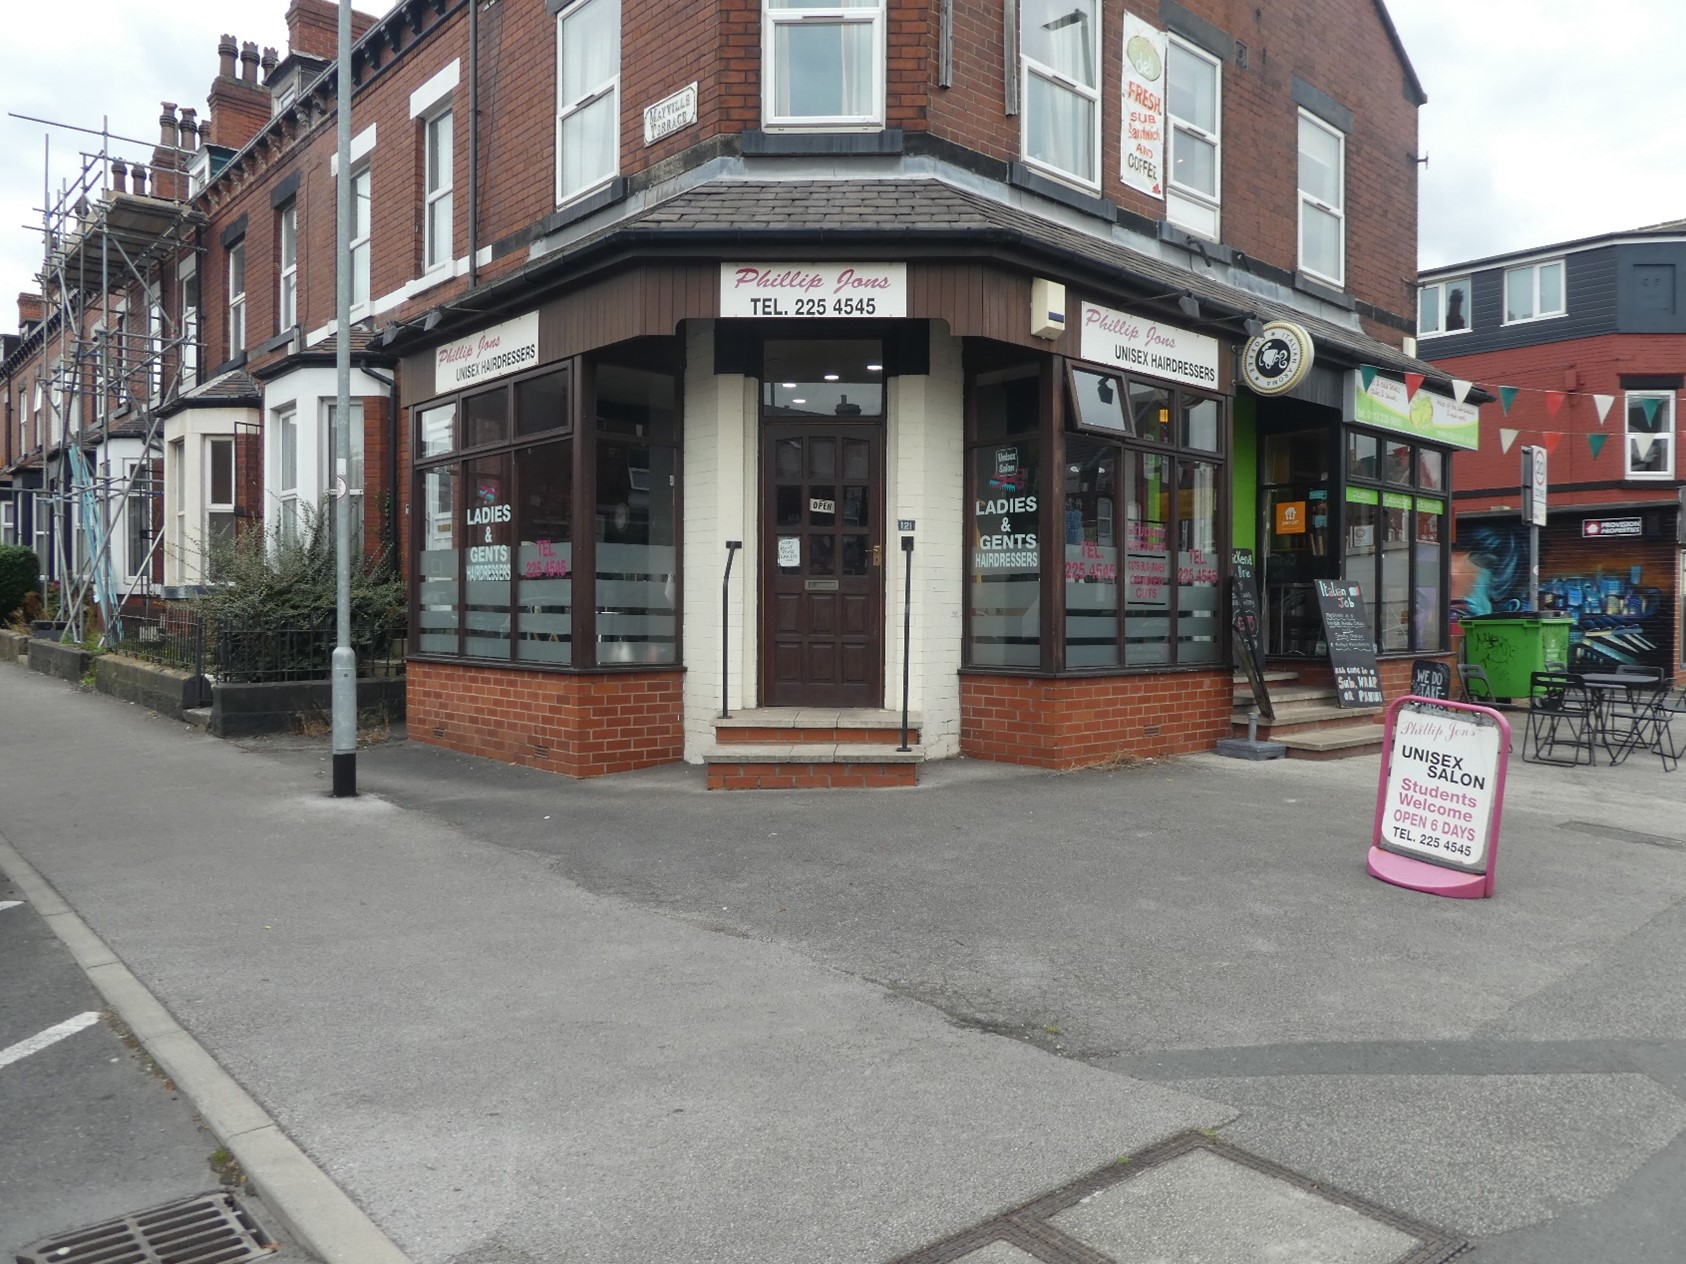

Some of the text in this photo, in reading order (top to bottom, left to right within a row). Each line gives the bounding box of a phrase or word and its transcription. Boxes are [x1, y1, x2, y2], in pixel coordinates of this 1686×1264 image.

[1128, 80, 1162, 116] FRESH
[650, 94, 690, 123] MAYVILLE
[1130, 111, 1156, 124] SUB
[651, 111, 687, 138] TERRACE
[1136, 143, 1153, 158] AND
[1128, 152, 1158, 181] COFFEE
[735, 267, 891, 294] Phillip Jons
[751, 297, 876, 316] TEL. 225 4545
[1085, 308, 1176, 349] Phillip Jons
[438, 335, 501, 367] Phillip Jons
[1281, 332, 1298, 364] ITALIAN
[456, 344, 536, 381] UNISEX HAIRDRESSERS
[1115, 344, 1215, 382] UNISEX HAIRDRESSERS
[1266, 368, 1293, 386] AROMA
[467, 504, 511, 525] LADIES
[813, 501, 832, 511] OPEN
[976, 496, 1037, 516] LADIES
[900, 521, 913, 530] 121
[1001, 517, 1011, 532] &
[485, 526, 492, 543] &
[980, 534, 1037, 550] GENTS
[470, 544, 508, 562] GENTS
[537, 540, 556, 557] TEL.
[1081, 541, 1104, 559] TEL.
[1189, 549, 1207, 564] TEL.
[525, 560, 567, 578] 225 4545
[975, 552, 1037, 568] HAIRDRESSERS
[466, 564, 511, 581] HAIRDRESSERS
[1065, 562, 1116, 579] 225 4545
[1178, 568, 1193, 583] 225
[1196, 568, 1217, 583] 4545
[1136, 588, 1157, 598] CUTS
[1319, 581, 1346, 597] Italian
[1338, 597, 1354, 608] Job
[1357, 676, 1377, 688] WRAP
[1416, 668, 1430, 684] WE
[1431, 671, 1443, 686] DO
[1400, 721, 1443, 741] Phillip
[1402, 745, 1464, 771] UNISEX
[1427, 765, 1485, 790] SALON
[1401, 777, 1477, 808] Students
[1399, 792, 1473, 823] Welcome
[1394, 809, 1475, 842] OPEN 6 DAYS
[1393, 826, 1472, 856] TEL. 225 4545
